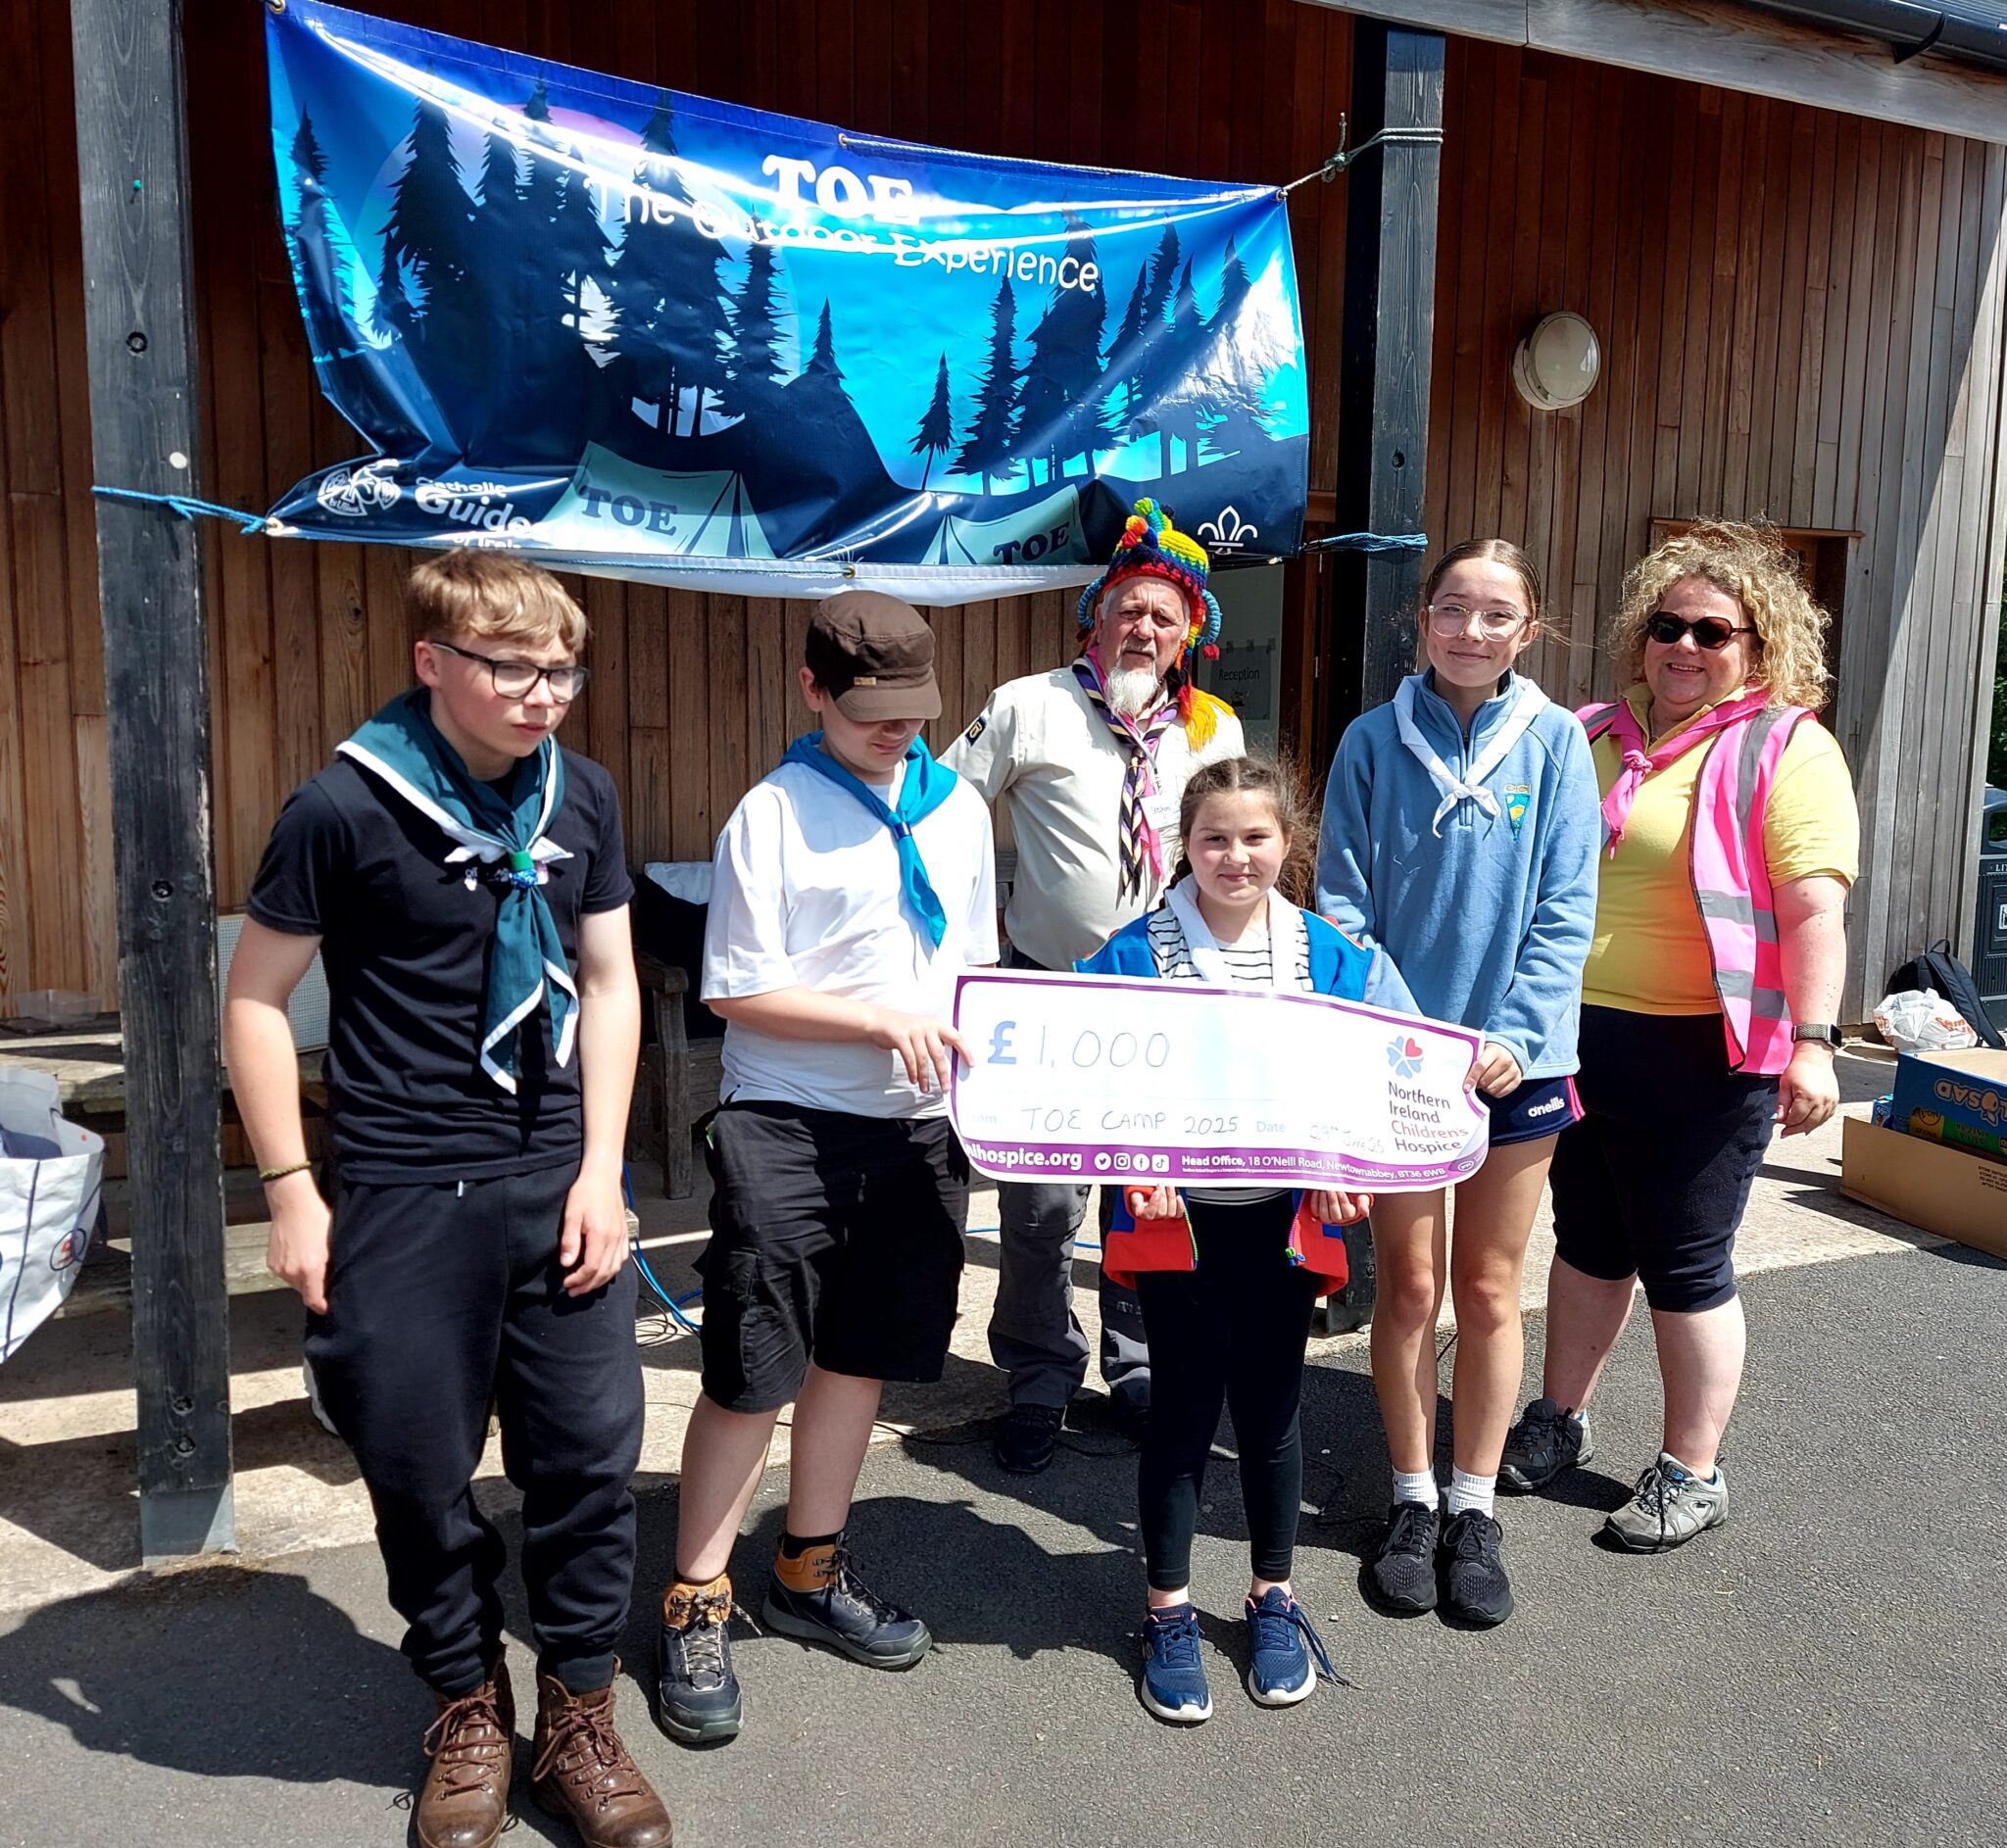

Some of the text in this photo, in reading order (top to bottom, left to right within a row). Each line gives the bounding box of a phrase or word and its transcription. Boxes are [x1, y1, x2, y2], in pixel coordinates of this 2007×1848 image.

[761, 154, 921, 225] TOE
[889, 231, 1100, 292] Experience
[578, 484, 678, 537] TOE
[993, 522, 1070, 565] TOE
[1218, 667, 1260, 682] Reception
[1388, 1081, 1451, 1109] Northern
[1021, 1107, 1082, 1133] TOE
[1183, 1115, 1239, 1135] 2025
[1255, 1120, 1287, 1133] Date
[1390, 1100, 1441, 1124] Ireland
[1392, 1119, 1469, 1139] Children's
[1395, 1137, 1463, 1154] Hospice
[1181, 1155, 1209, 1167] Head
[1211, 1155, 1247, 1167] Office,
[1248, 1156, 1261, 1166] 18
